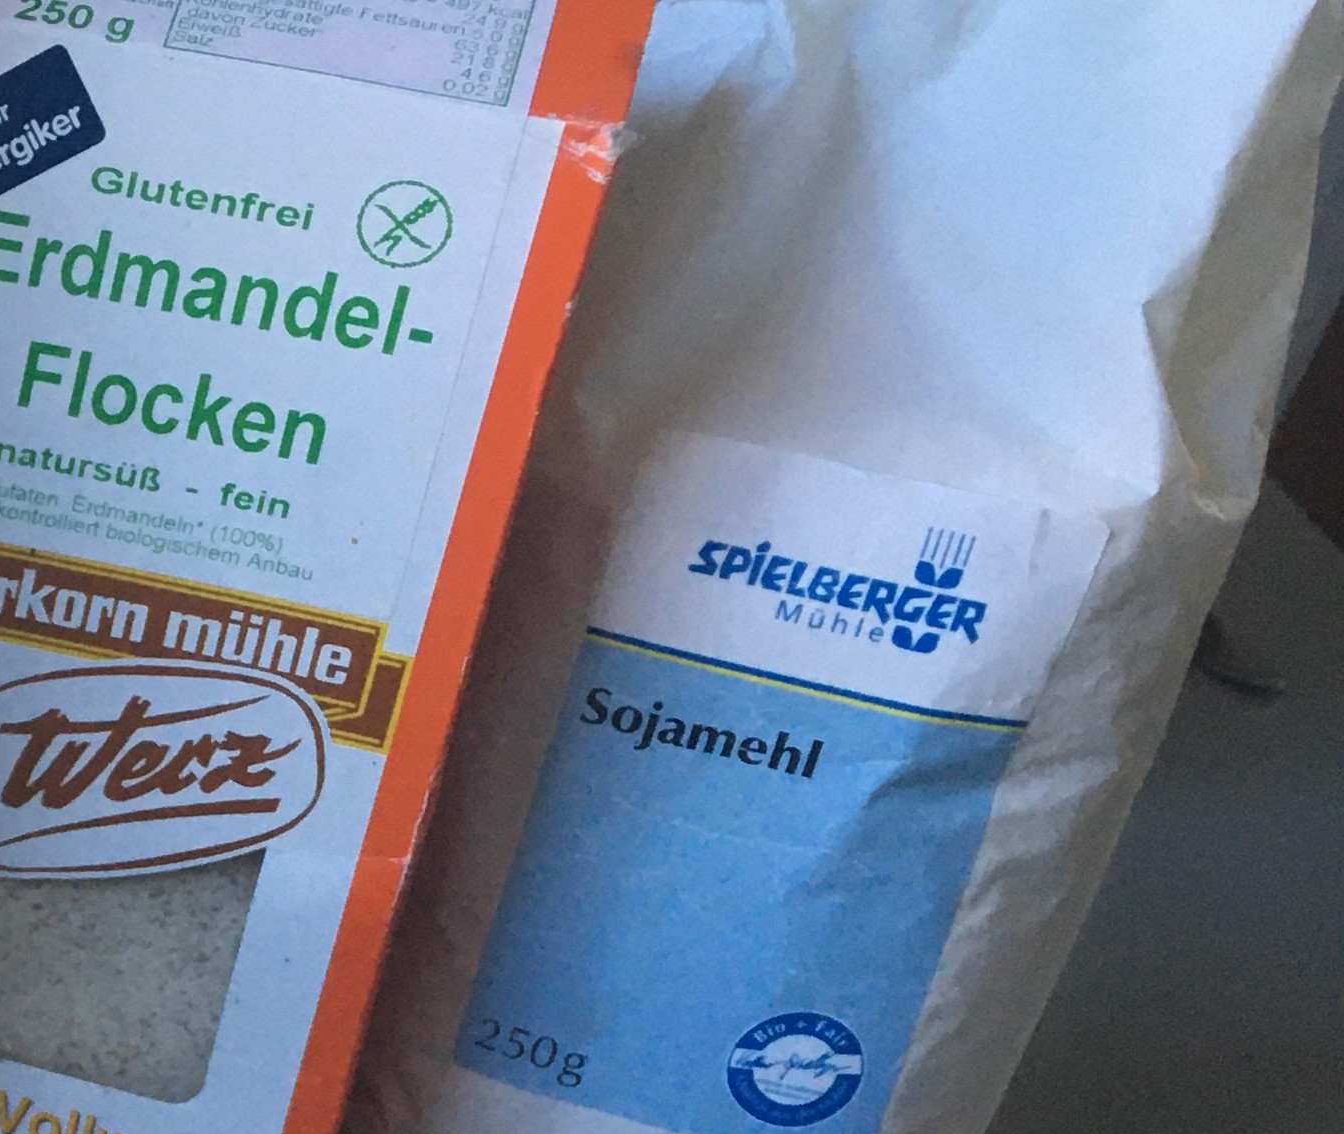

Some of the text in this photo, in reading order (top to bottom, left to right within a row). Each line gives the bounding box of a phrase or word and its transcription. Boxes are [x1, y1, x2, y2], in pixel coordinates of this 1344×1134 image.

[14, 0, 135, 44] 250 g
[173, 30, 215, 48] Salz
[177, 17, 242, 38] Eiweiß
[187, 6, 247, 26] davon
[249, 15, 319, 39] Zucker
[90, 166, 315, 231] Glutenfrei
[16, 340, 327, 466] Flocken
[220, 482, 290, 519] fein
[105, 523, 242, 566] biologischem
[246, 551, 314, 583] Anbau
[210, 524, 283, 556] (100%)
[774, 599, 886, 644] Mühle
[161, 609, 354, 686] mühle
[578, 685, 826, 781] Sojamehl
[753, 1023, 786, 1043] Bio
